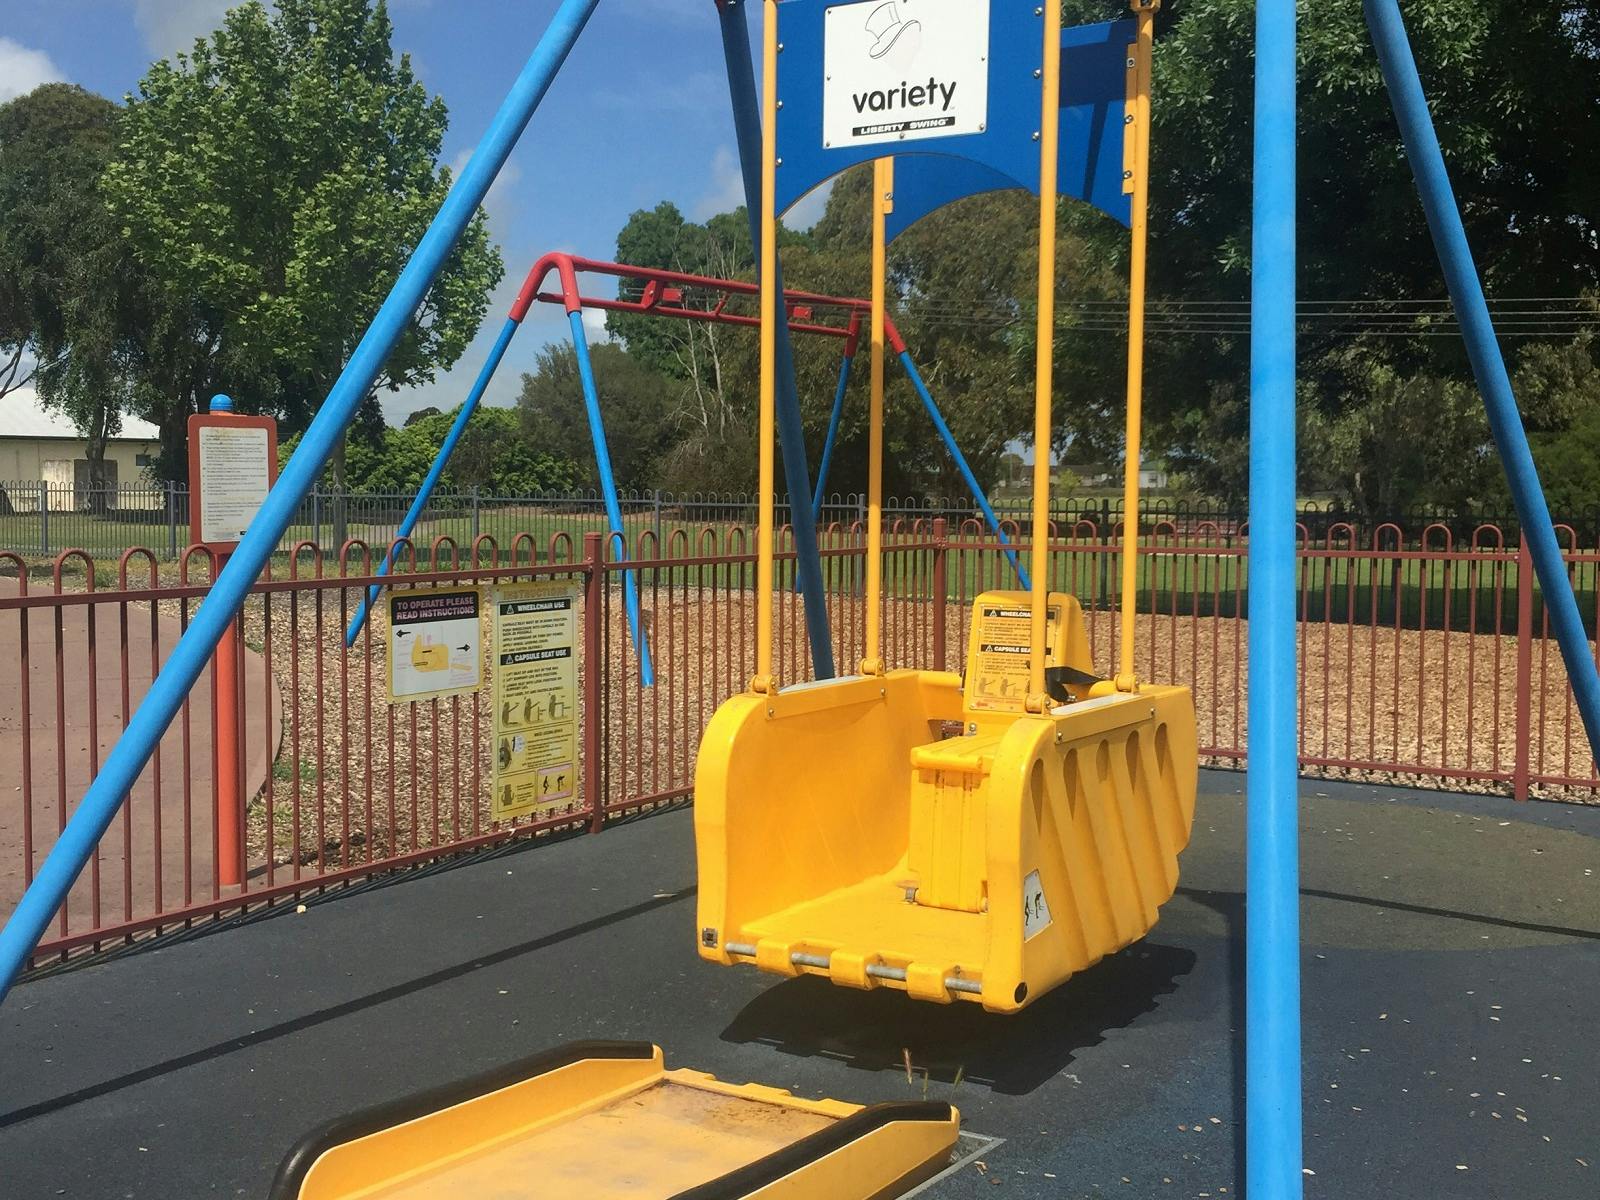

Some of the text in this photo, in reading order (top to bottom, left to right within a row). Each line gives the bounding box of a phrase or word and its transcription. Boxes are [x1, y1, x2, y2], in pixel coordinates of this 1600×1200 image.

[852, 77, 957, 114] variety
[860, 118, 948, 135] LIBERTY SWING
[397, 596, 474, 610] TO OPERATE PLEASE
[517, 601, 565, 612] WHEELCHAIR USE
[396, 606, 475, 620] READ INSTRUCTIONS
[514, 649, 567, 662] CAPSULE SEAT USE
